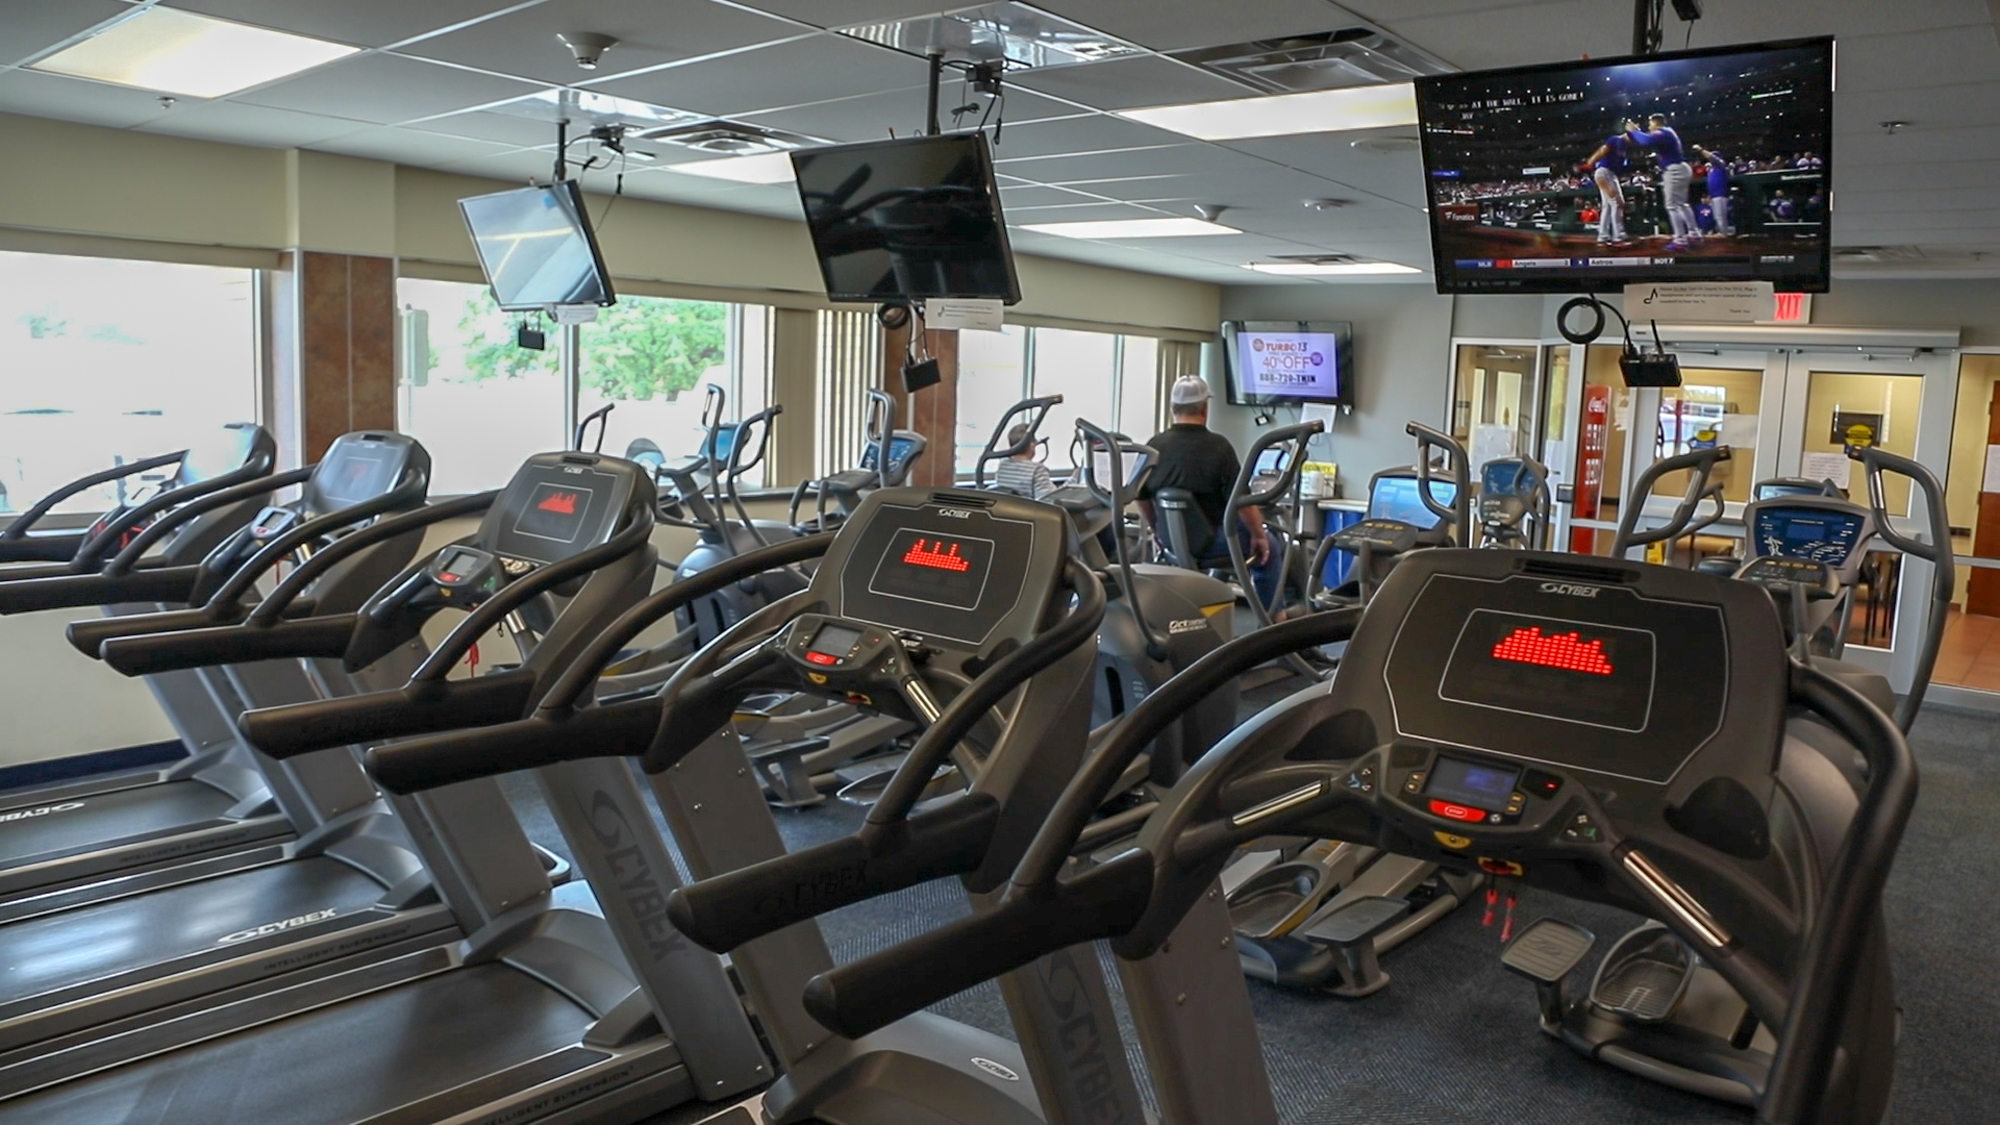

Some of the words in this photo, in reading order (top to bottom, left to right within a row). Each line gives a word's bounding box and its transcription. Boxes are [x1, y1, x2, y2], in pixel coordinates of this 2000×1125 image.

[1774, 295, 1802, 320] XIT
[1266, 343, 1297, 352] TURBO
[1298, 342, 1308, 352] 13
[1283, 356, 1310, 369] OFF
[1557, 584, 1600, 598] CYBEX
[604, 844, 689, 962] CYBEX
[256, 907, 337, 935] CYBEX
[1058, 1011, 1123, 1125] CYBE
